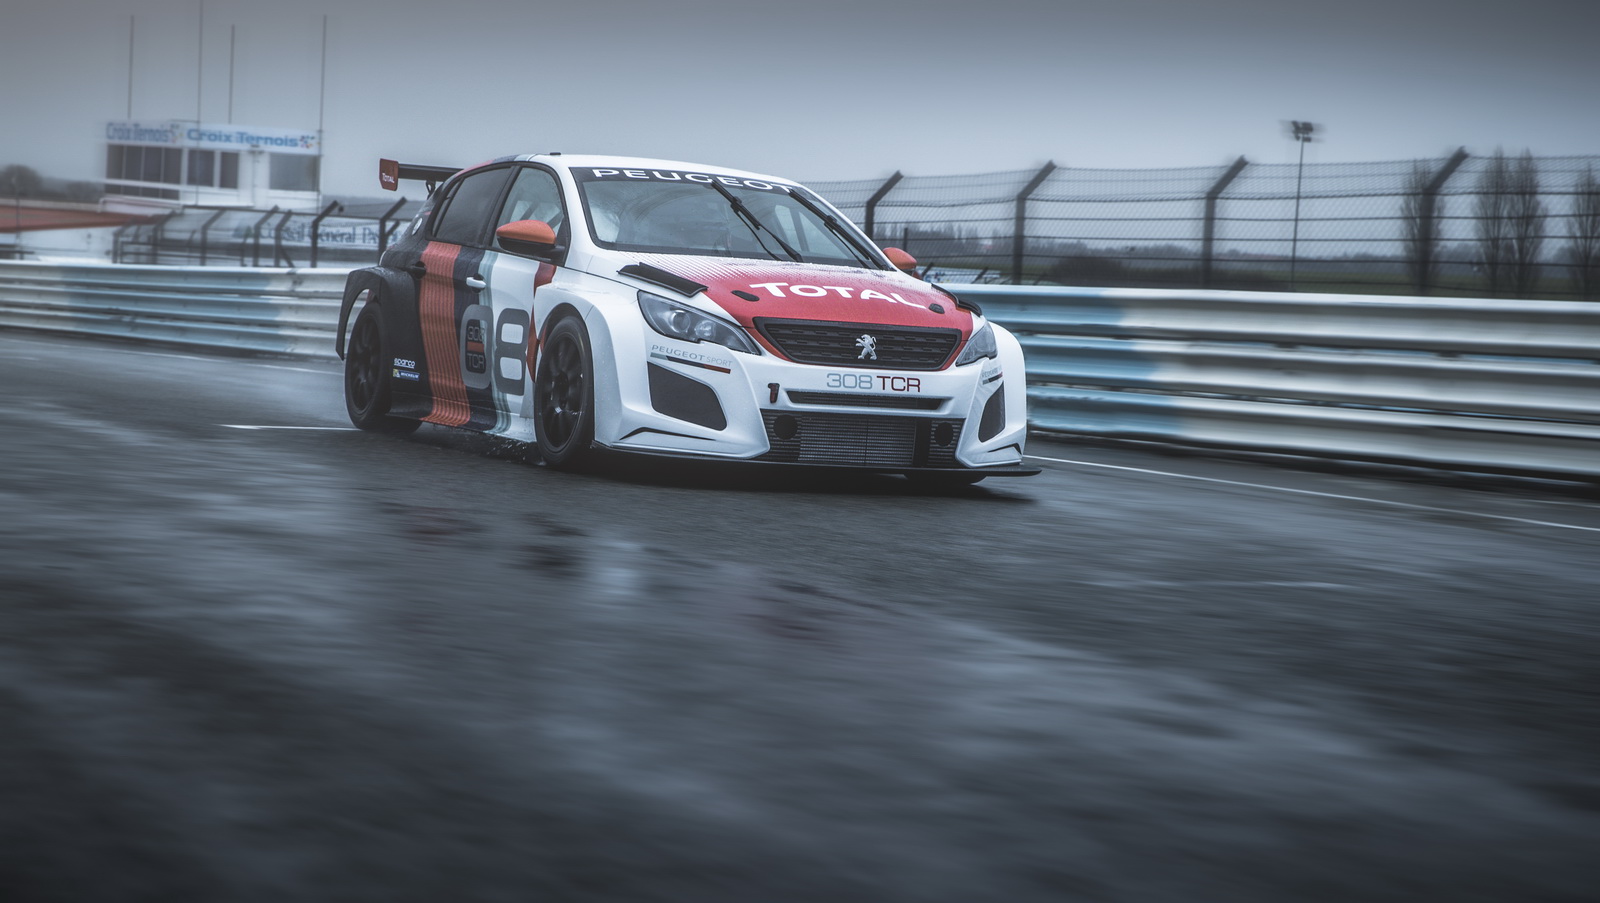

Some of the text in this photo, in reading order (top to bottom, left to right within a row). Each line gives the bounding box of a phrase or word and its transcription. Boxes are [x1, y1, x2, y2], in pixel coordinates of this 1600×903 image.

[186, 128, 299, 148] Croix Ternois
[592, 168, 794, 193] PEUGEOT
[749, 282, 926, 309] TOTAL
[394, 358, 416, 368] sparco
[651, 344, 734, 367] PEUGEOT SPORT
[826, 373, 921, 393] 308 TCR
